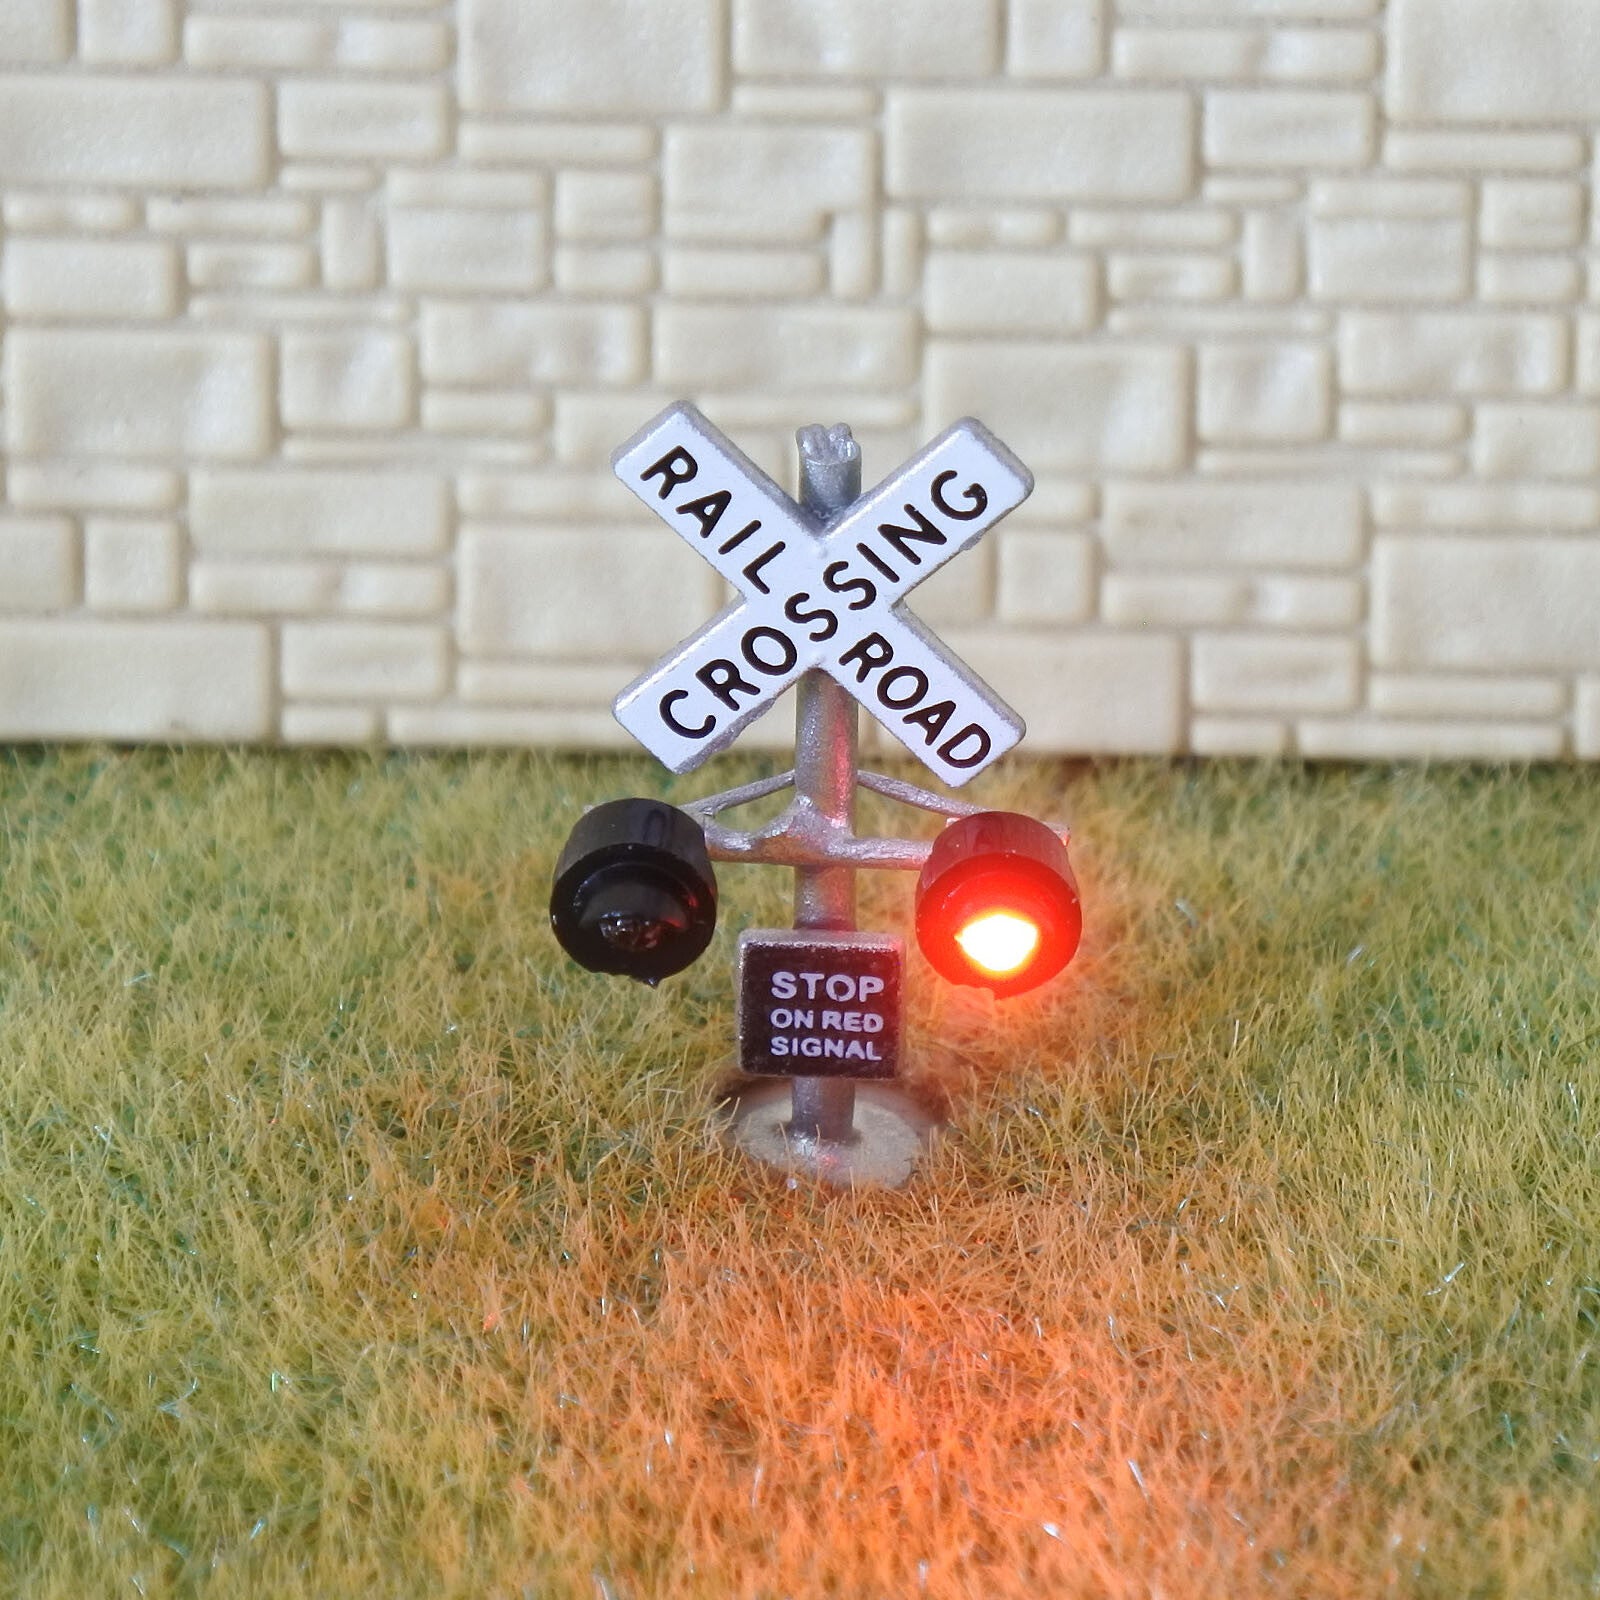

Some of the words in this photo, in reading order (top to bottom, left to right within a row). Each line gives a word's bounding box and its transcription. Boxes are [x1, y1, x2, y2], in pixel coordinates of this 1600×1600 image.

[640, 445, 786, 595] RAIL
[839, 632, 992, 769] ROAD
[659, 470, 988, 739] CROSSING
[771, 971, 884, 1002] STOP
[770, 1008, 814, 1029] ON
[822, 1010, 884, 1033] RED
[770, 1036, 882, 1061] SIGNAL
